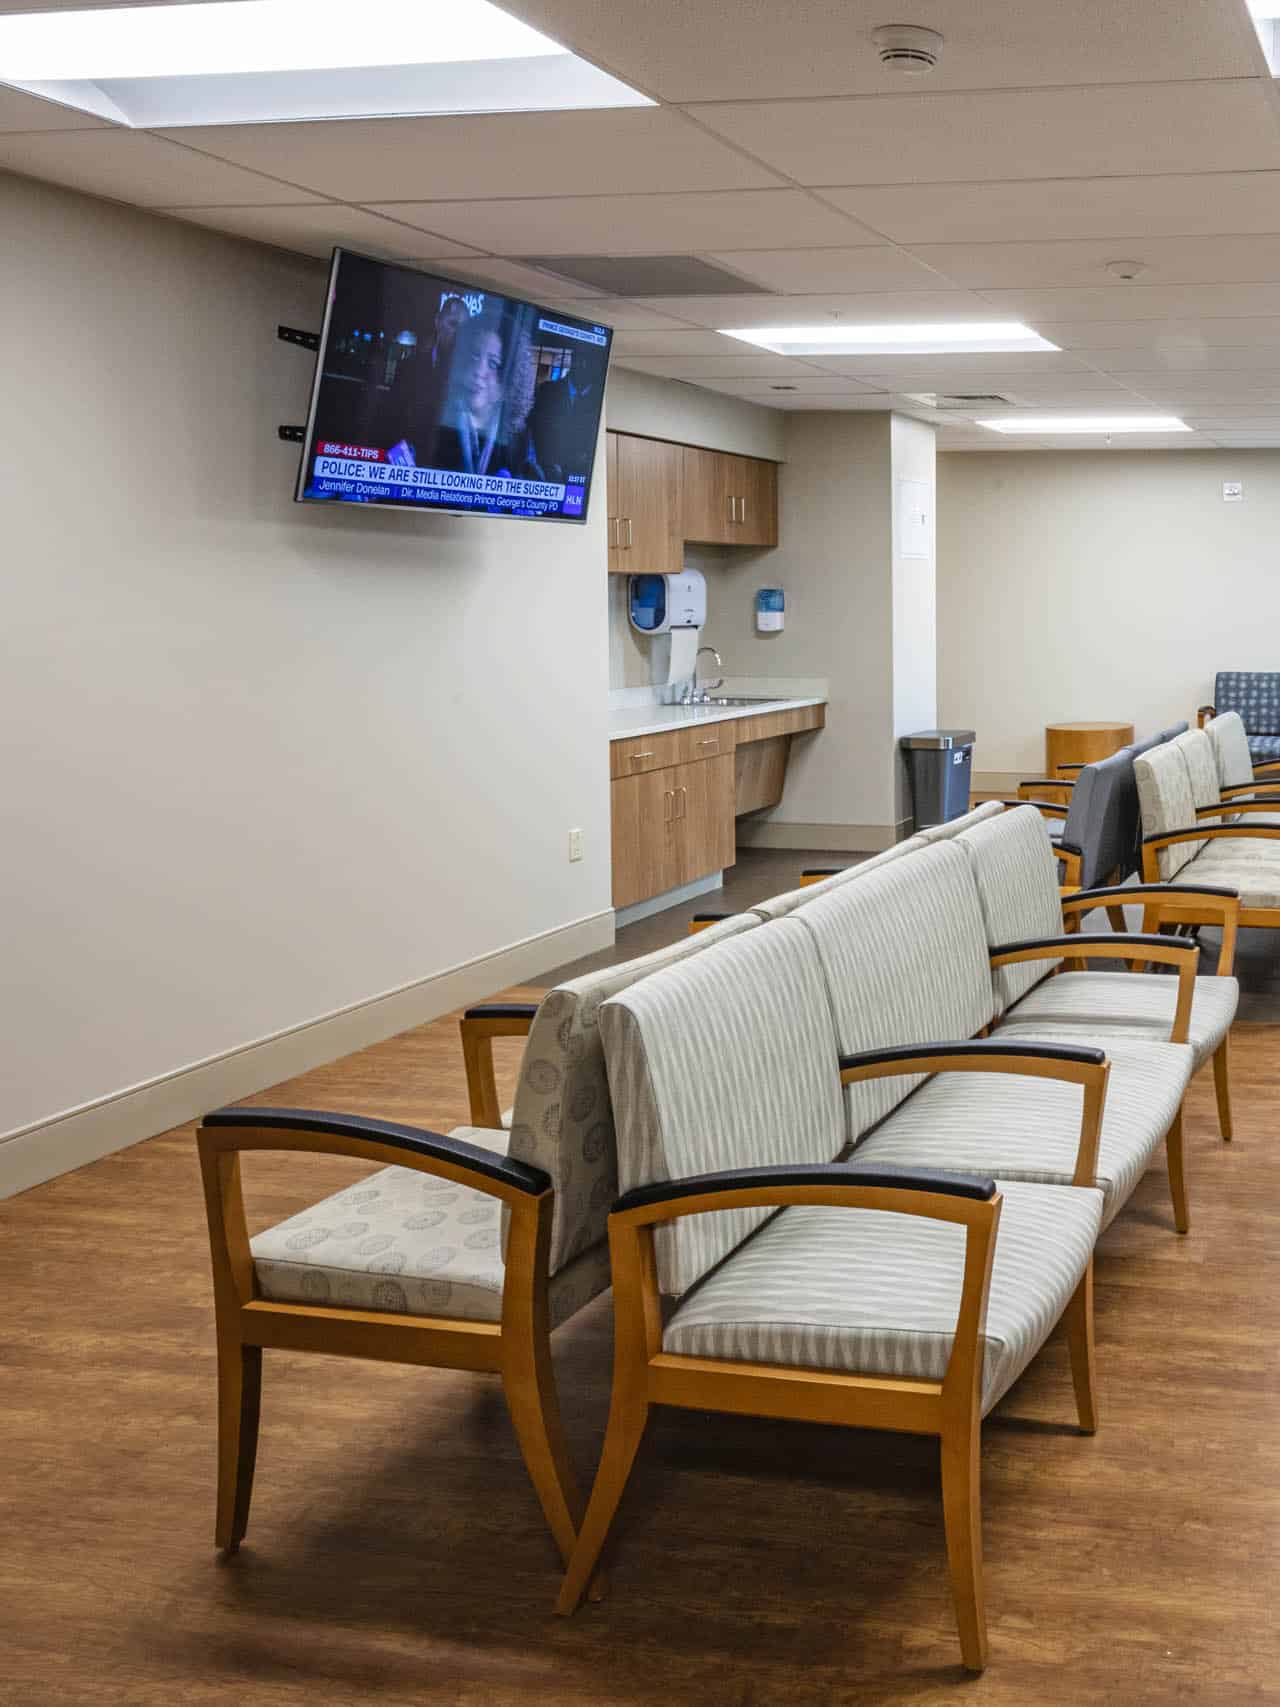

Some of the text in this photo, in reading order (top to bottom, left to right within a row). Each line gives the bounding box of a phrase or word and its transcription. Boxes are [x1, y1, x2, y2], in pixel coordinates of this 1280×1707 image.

[319, 479, 355, 493] Jennifer
[321, 460, 365, 478] POLICE:
[368, 465, 386, 479] WE
[388, 468, 410, 482] ARE
[412, 470, 438, 485] STILL
[441, 473, 482, 489] LOOKING
[485, 479, 503, 491] FOR
[505, 481, 522, 494] THE
